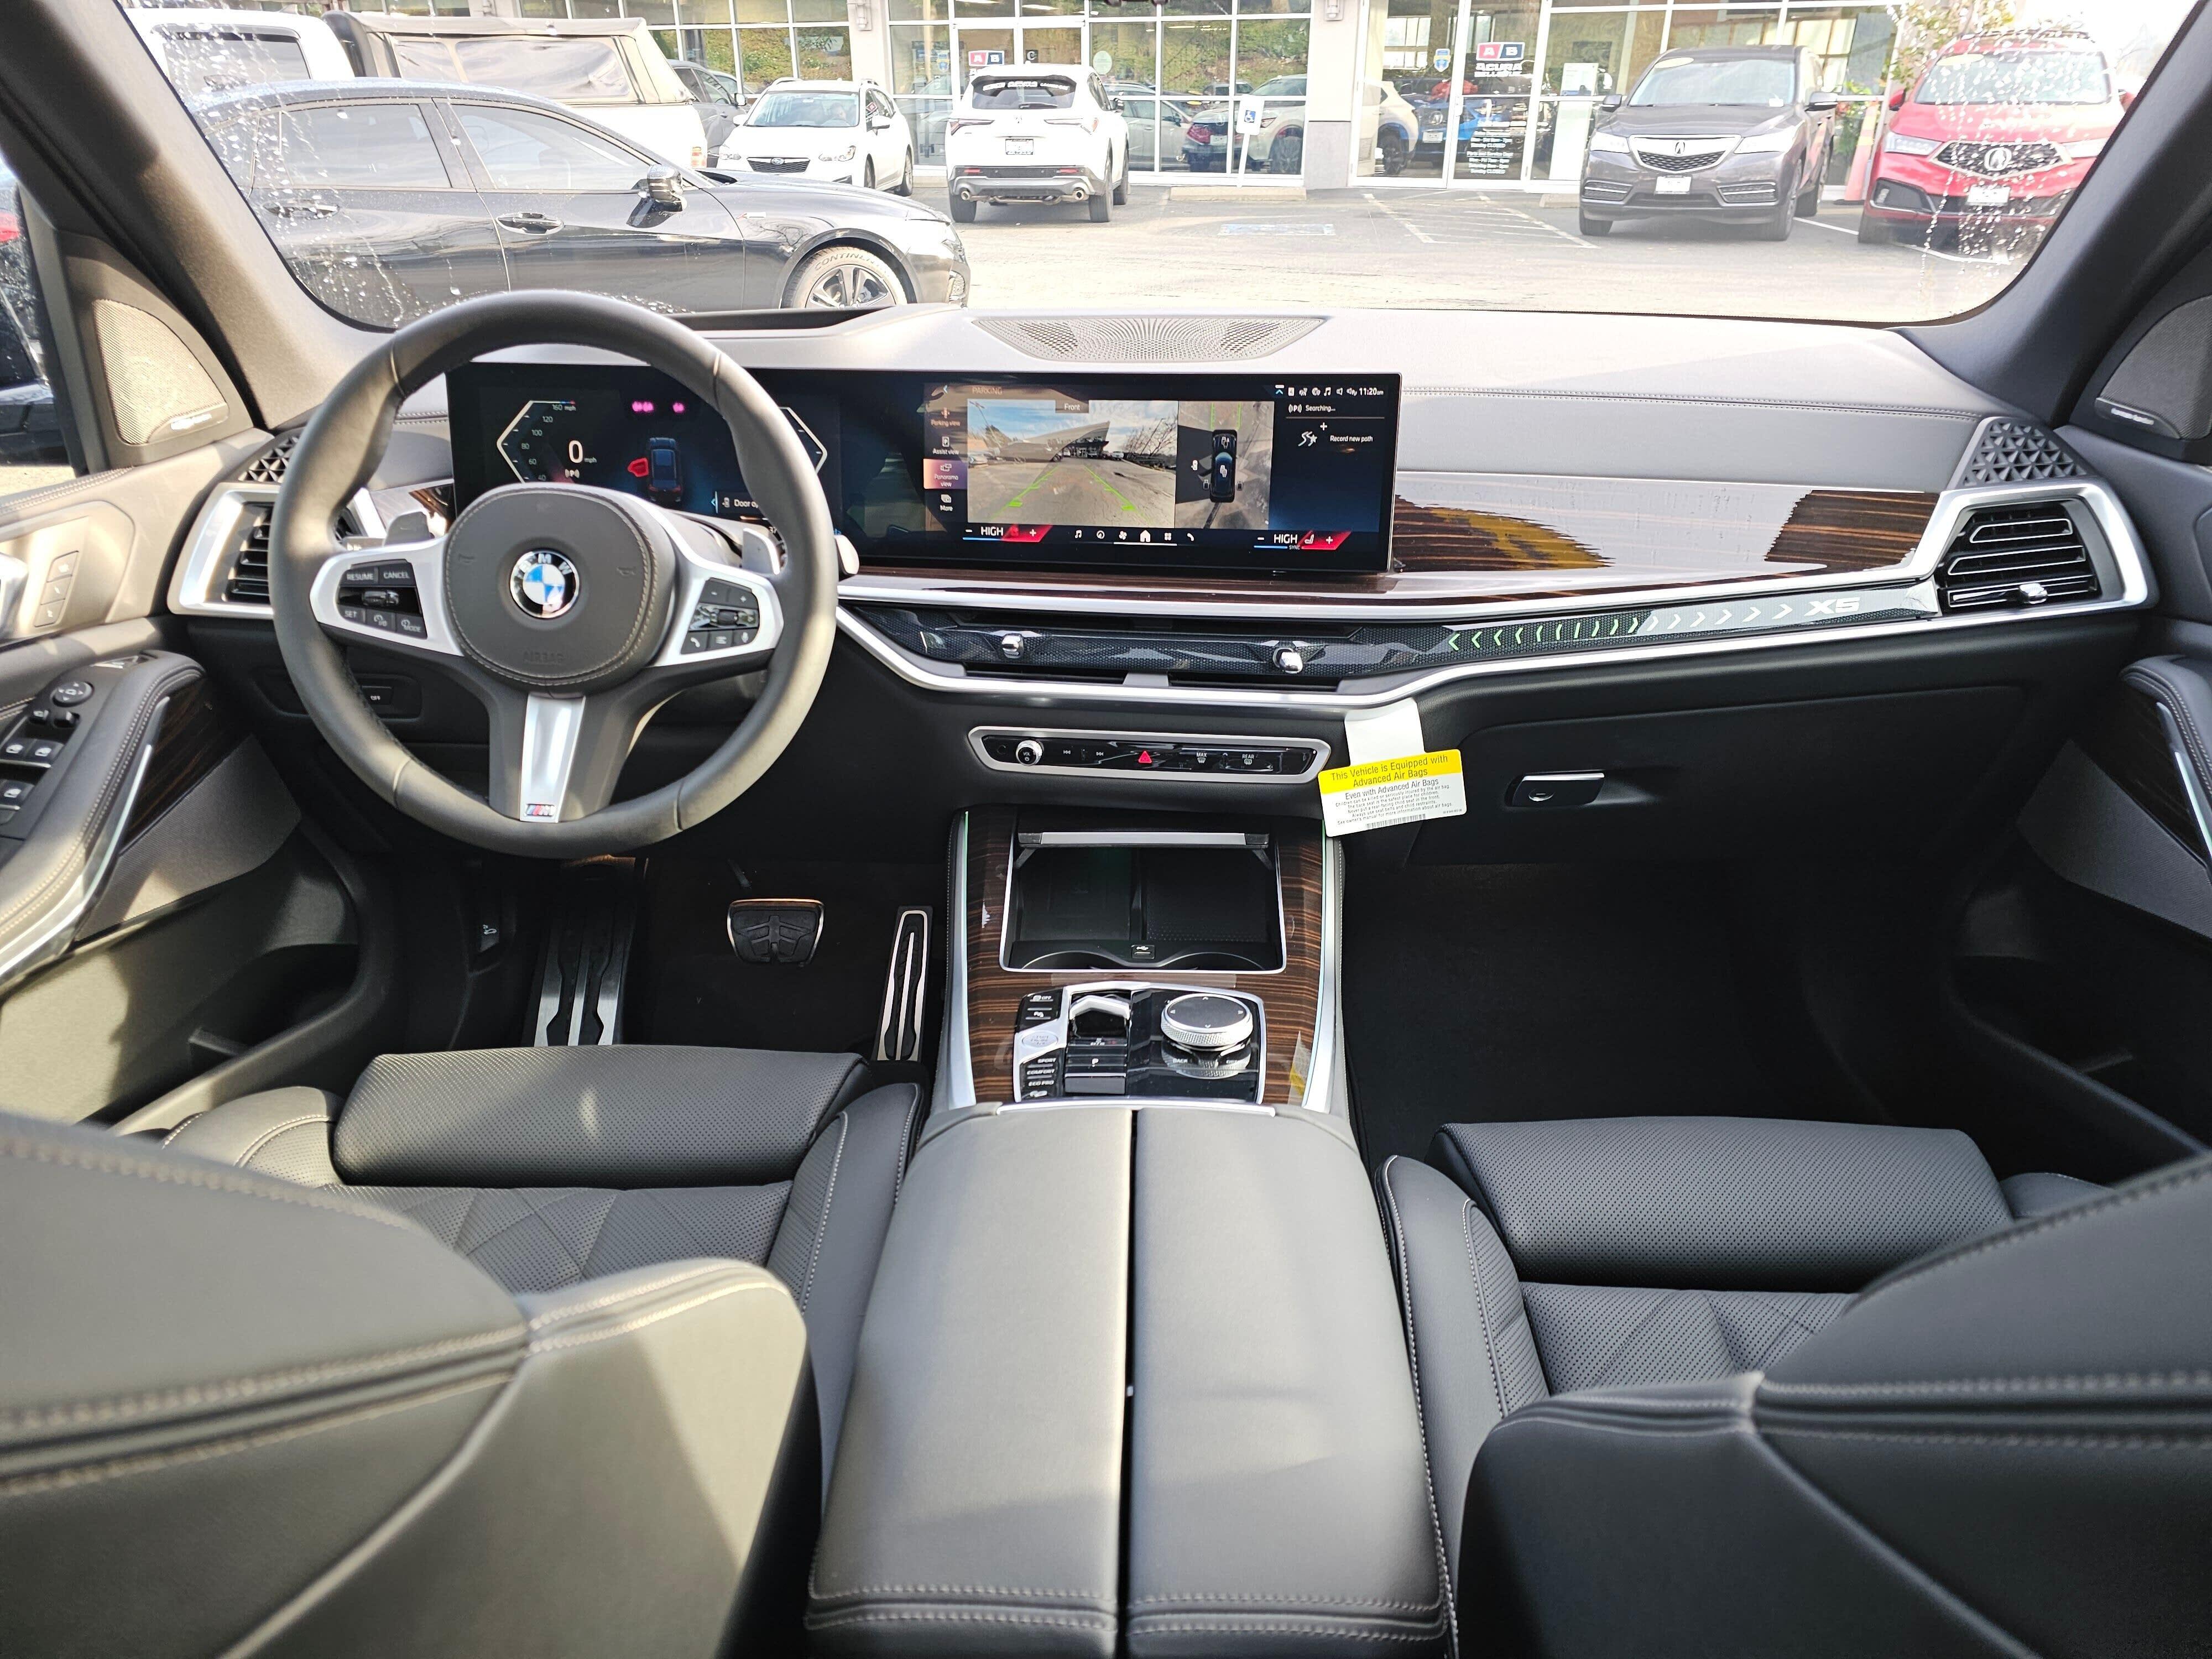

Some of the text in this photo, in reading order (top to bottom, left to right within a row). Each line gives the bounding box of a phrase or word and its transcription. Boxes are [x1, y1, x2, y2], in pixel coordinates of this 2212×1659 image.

[568, 440, 583, 463] 0
[734, 499, 750, 507] Door
[980, 526, 1004, 536] HIGH
[1274, 534, 1298, 544] HIGH
[346, 573, 374, 581] RESUME
[383, 571, 410, 580] CANCEL
[1803, 597, 1860, 617] X5
[345, 610, 358, 618] SET
[403, 624, 421, 633] MODE
[1331, 771, 1347, 780] This
[1350, 766, 1378, 777] Vehicle
[1391, 758, 1427, 771] Equipped
[1431, 755, 1448, 764] with
[1353, 768, 1428, 787] Advanced Air Bags
[1378, 783, 1409, 793] Advanced
[1422, 778, 1438, 787] Bags
